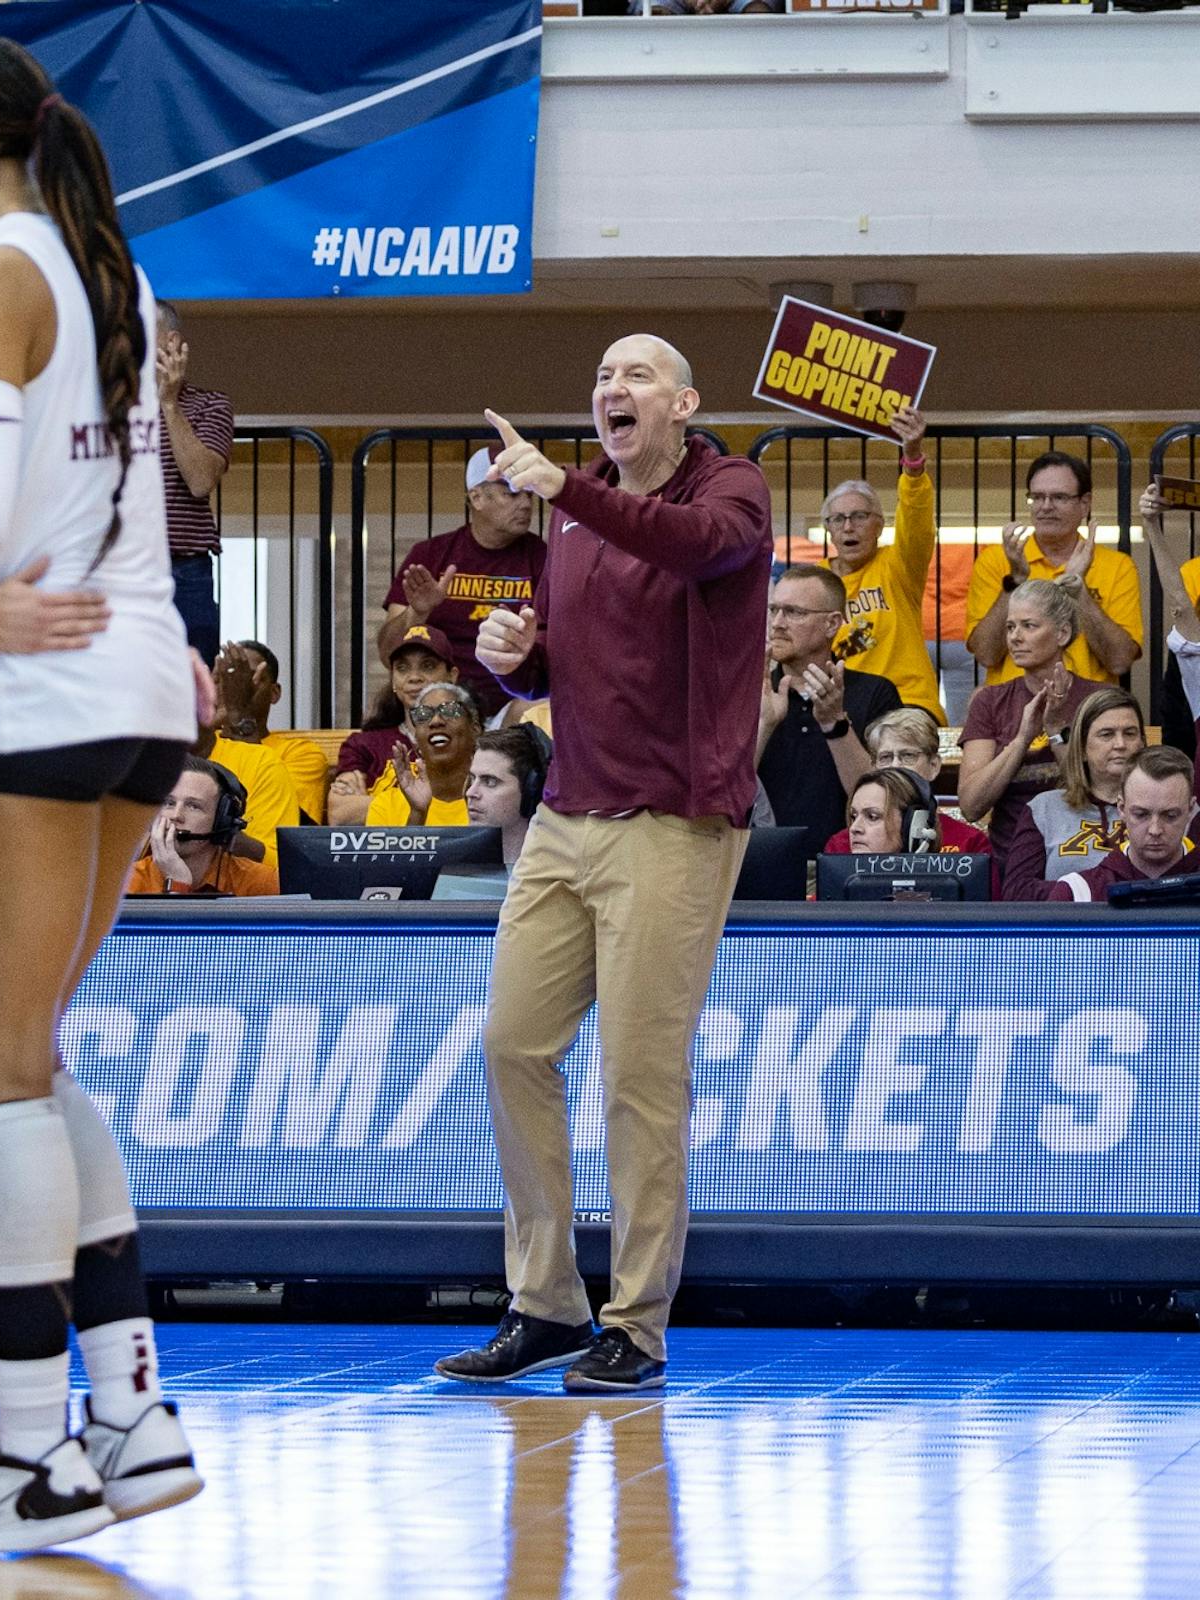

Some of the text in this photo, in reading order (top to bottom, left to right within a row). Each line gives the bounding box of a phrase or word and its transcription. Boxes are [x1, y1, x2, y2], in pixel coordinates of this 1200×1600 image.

[311, 223, 520, 277] #NCAAVB
[803, 321, 898, 384] POINT
[332, 854, 435, 863] REPLAY
